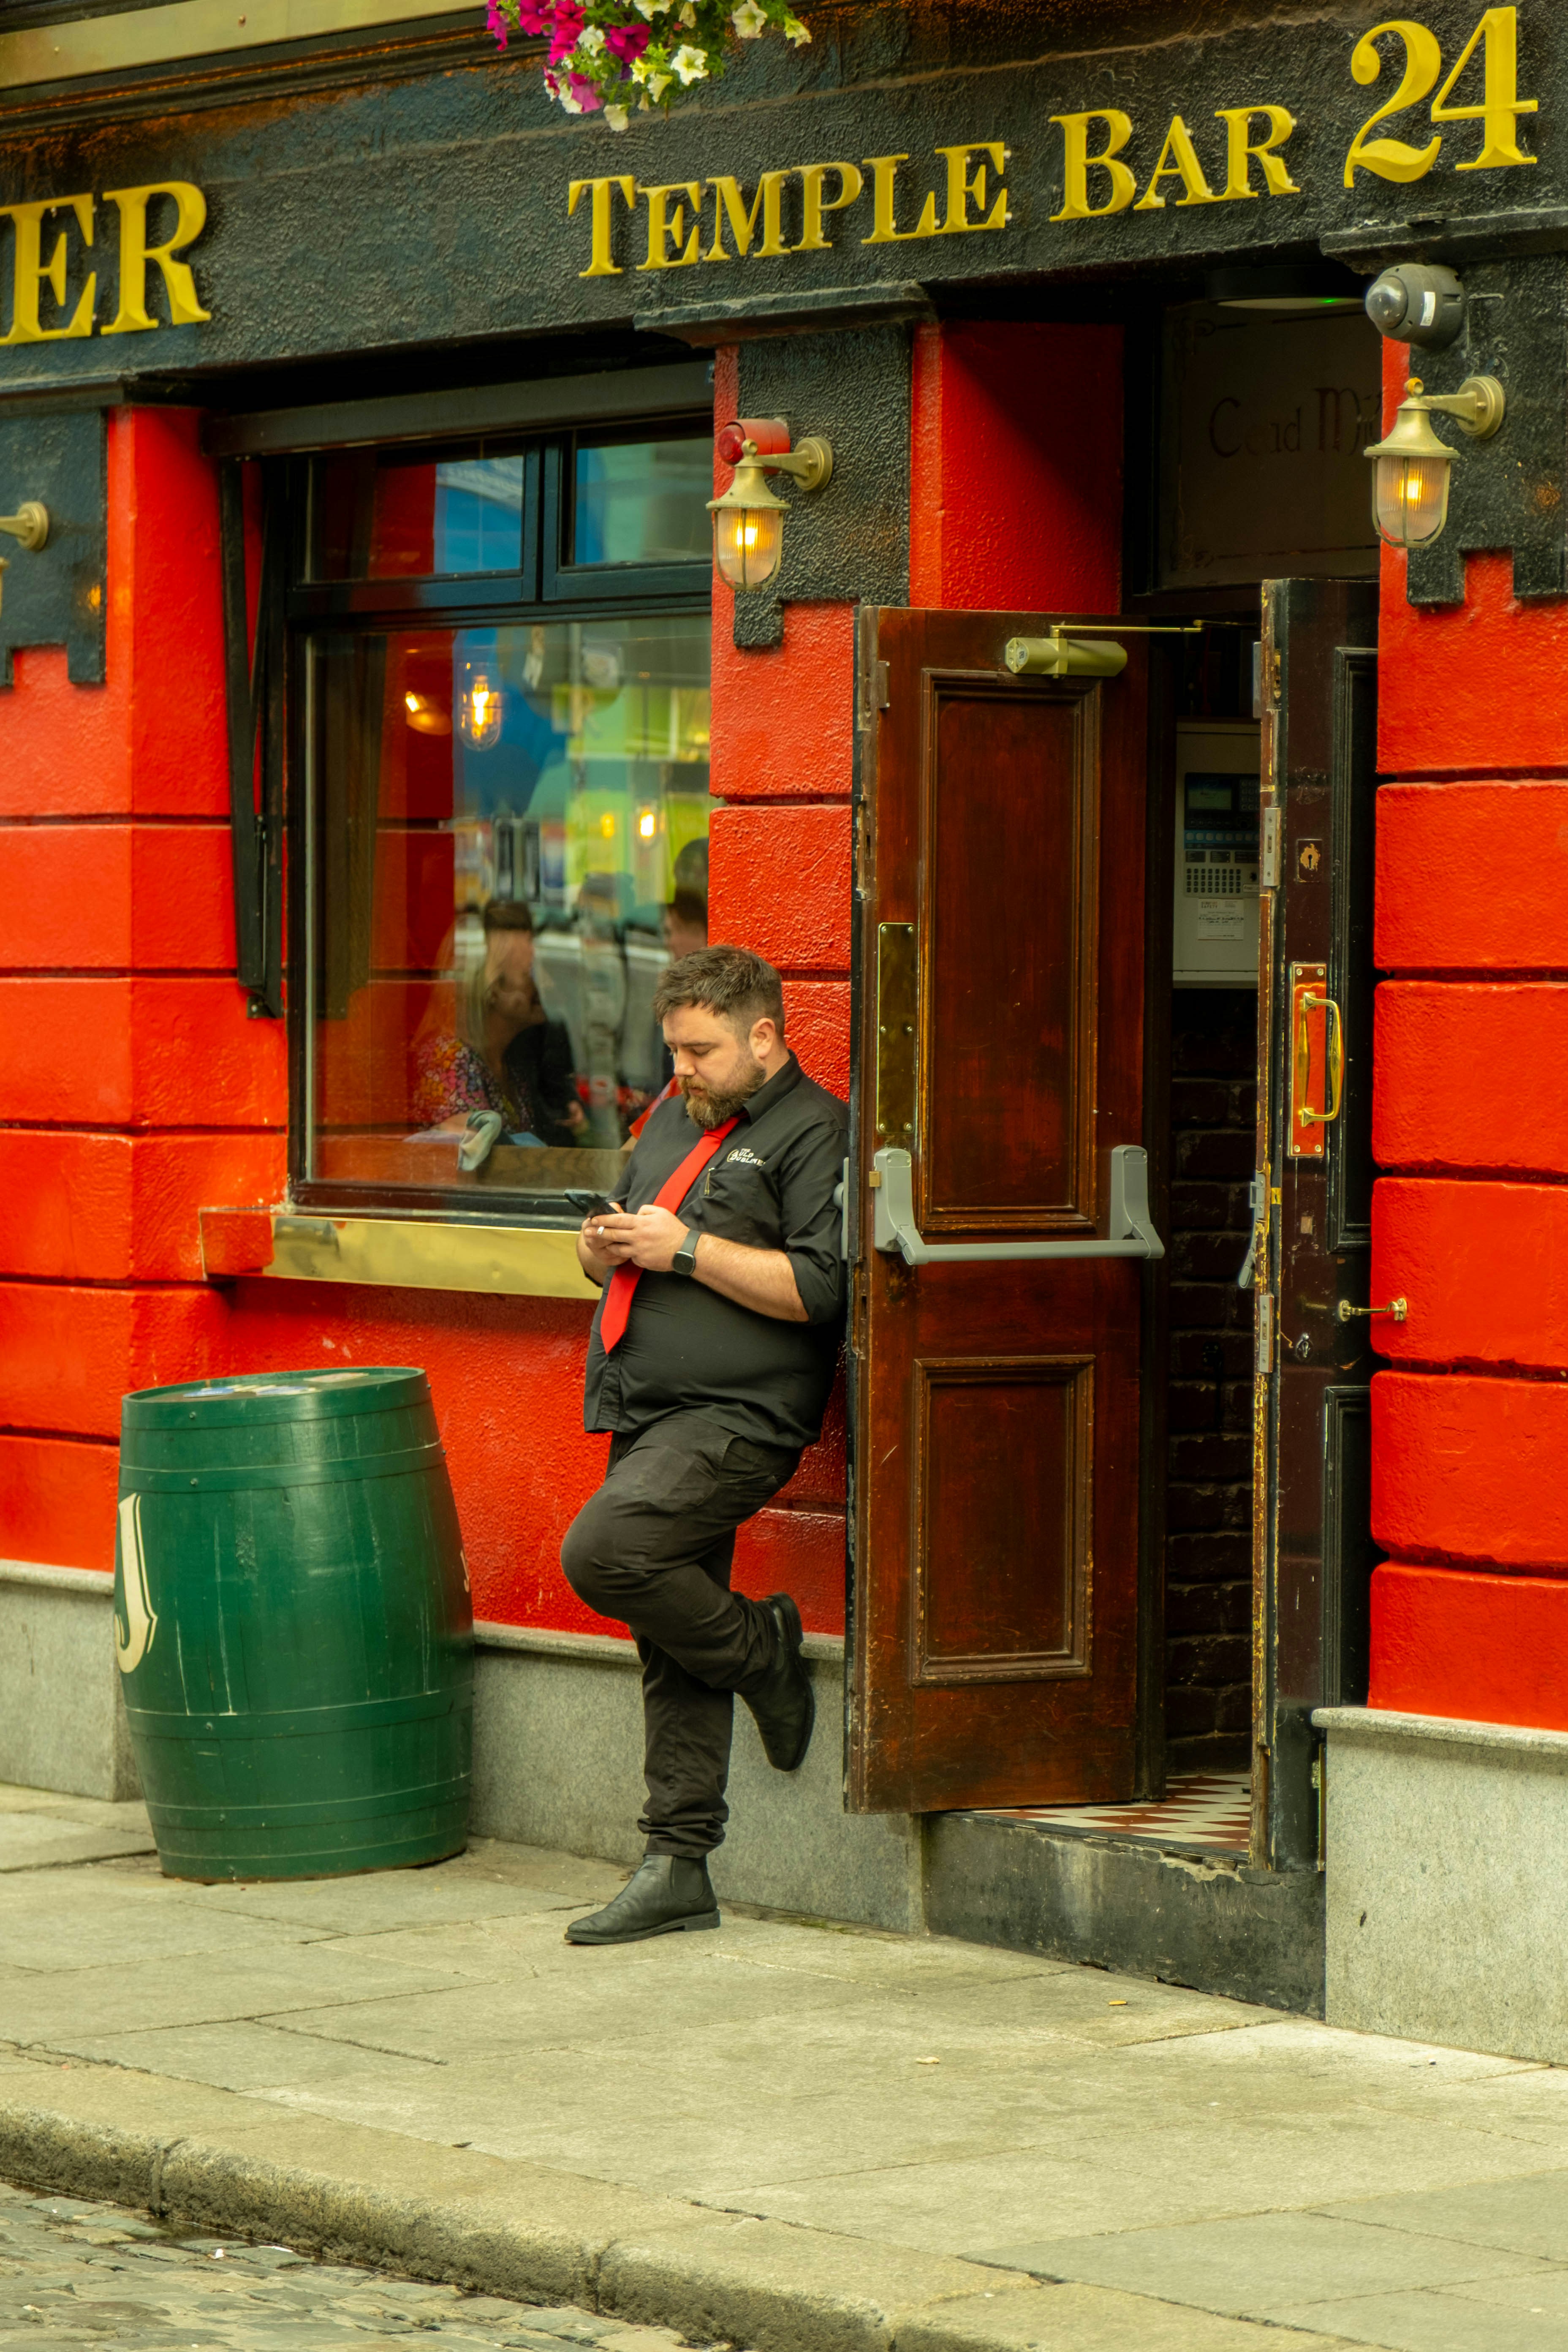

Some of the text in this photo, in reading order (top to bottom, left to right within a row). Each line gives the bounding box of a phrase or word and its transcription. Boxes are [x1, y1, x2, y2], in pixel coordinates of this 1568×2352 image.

[568, 6, 1538, 277] TEMPLE BAR 24
[0, 181, 211, 345] ER
